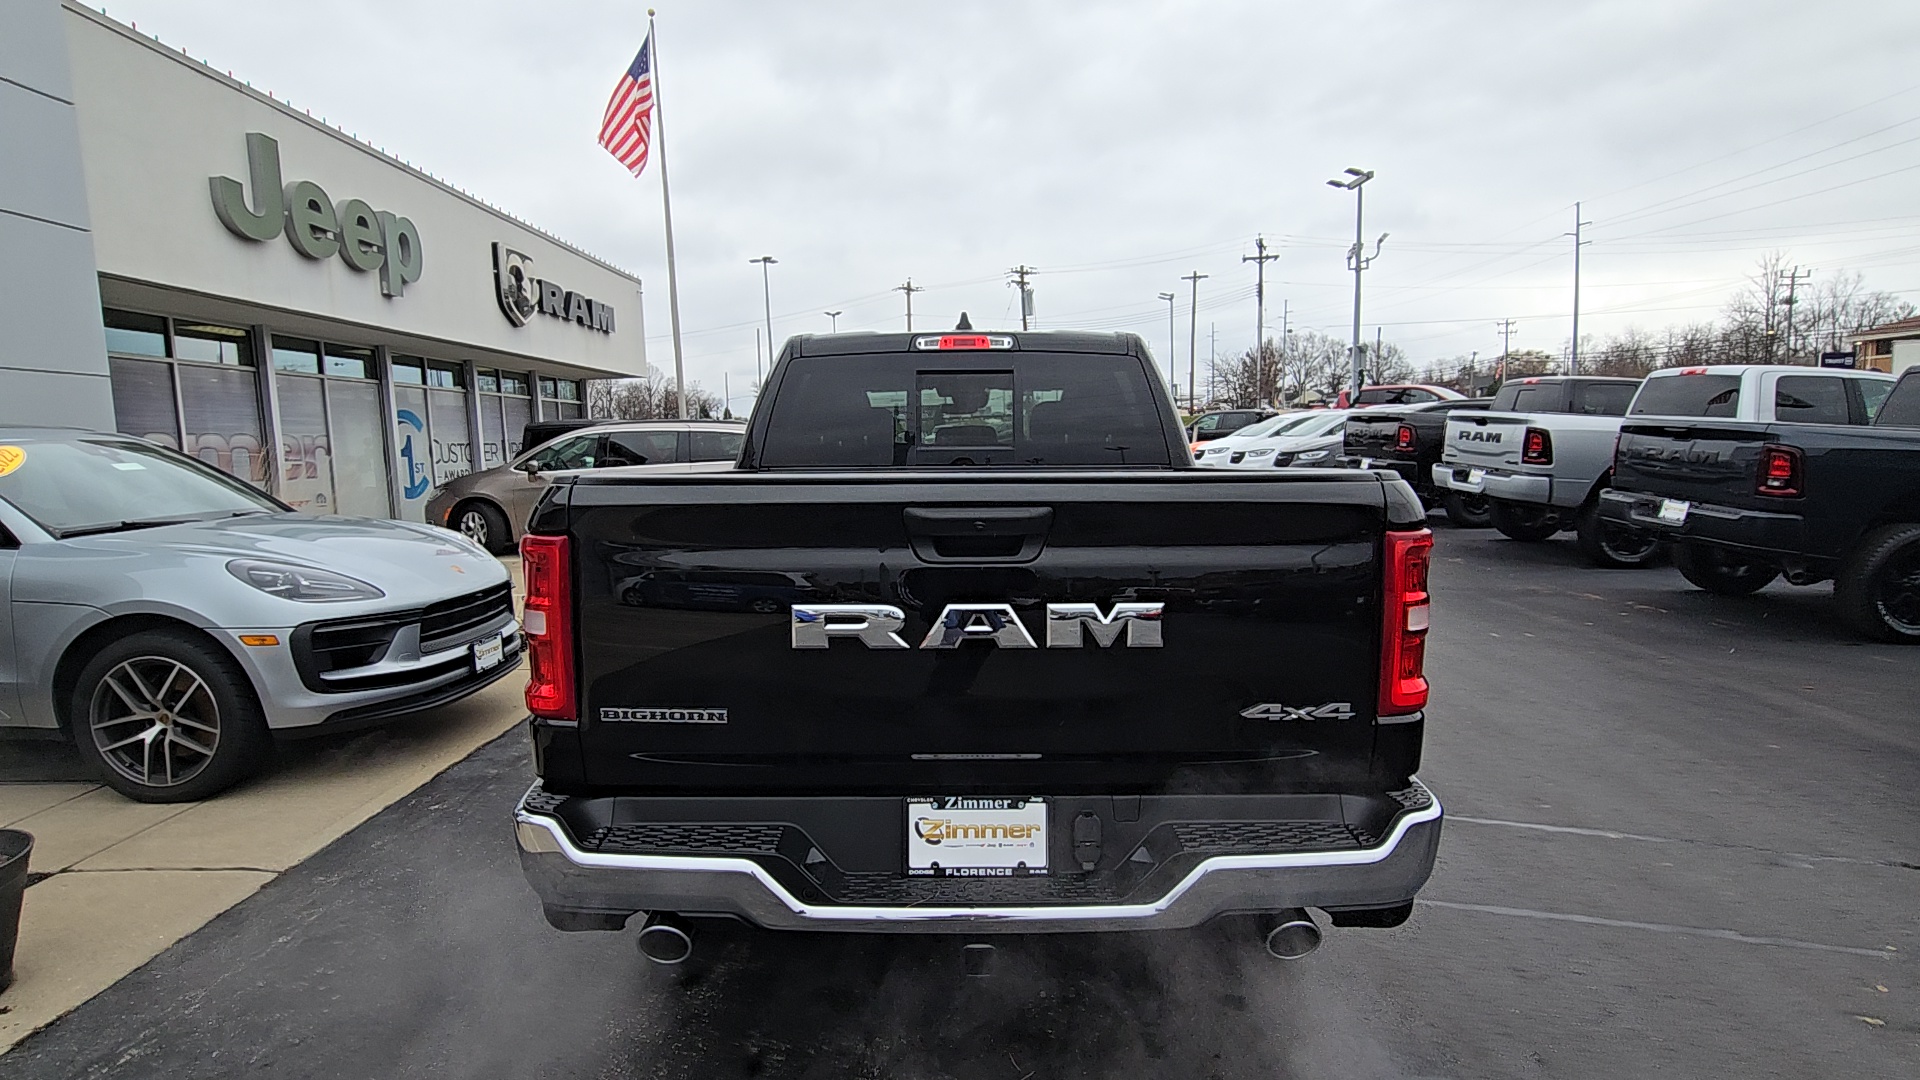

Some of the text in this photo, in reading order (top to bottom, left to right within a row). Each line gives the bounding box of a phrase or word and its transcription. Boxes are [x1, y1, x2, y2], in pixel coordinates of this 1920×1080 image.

[209, 132, 423, 298] Jeep
[537, 279, 616, 334] RAM
[1458, 430, 1503, 443] RAM
[1643, 446, 1720, 463] RAM
[792, 603, 1165, 649] RAM
[600, 708, 728, 724] BIGHORN
[1240, 702, 1356, 720] 4x4
[944, 796, 1012, 809] Zimmer
[921, 819, 1041, 839] Zimmer
[945, 868, 1013, 876] FLORENCE
